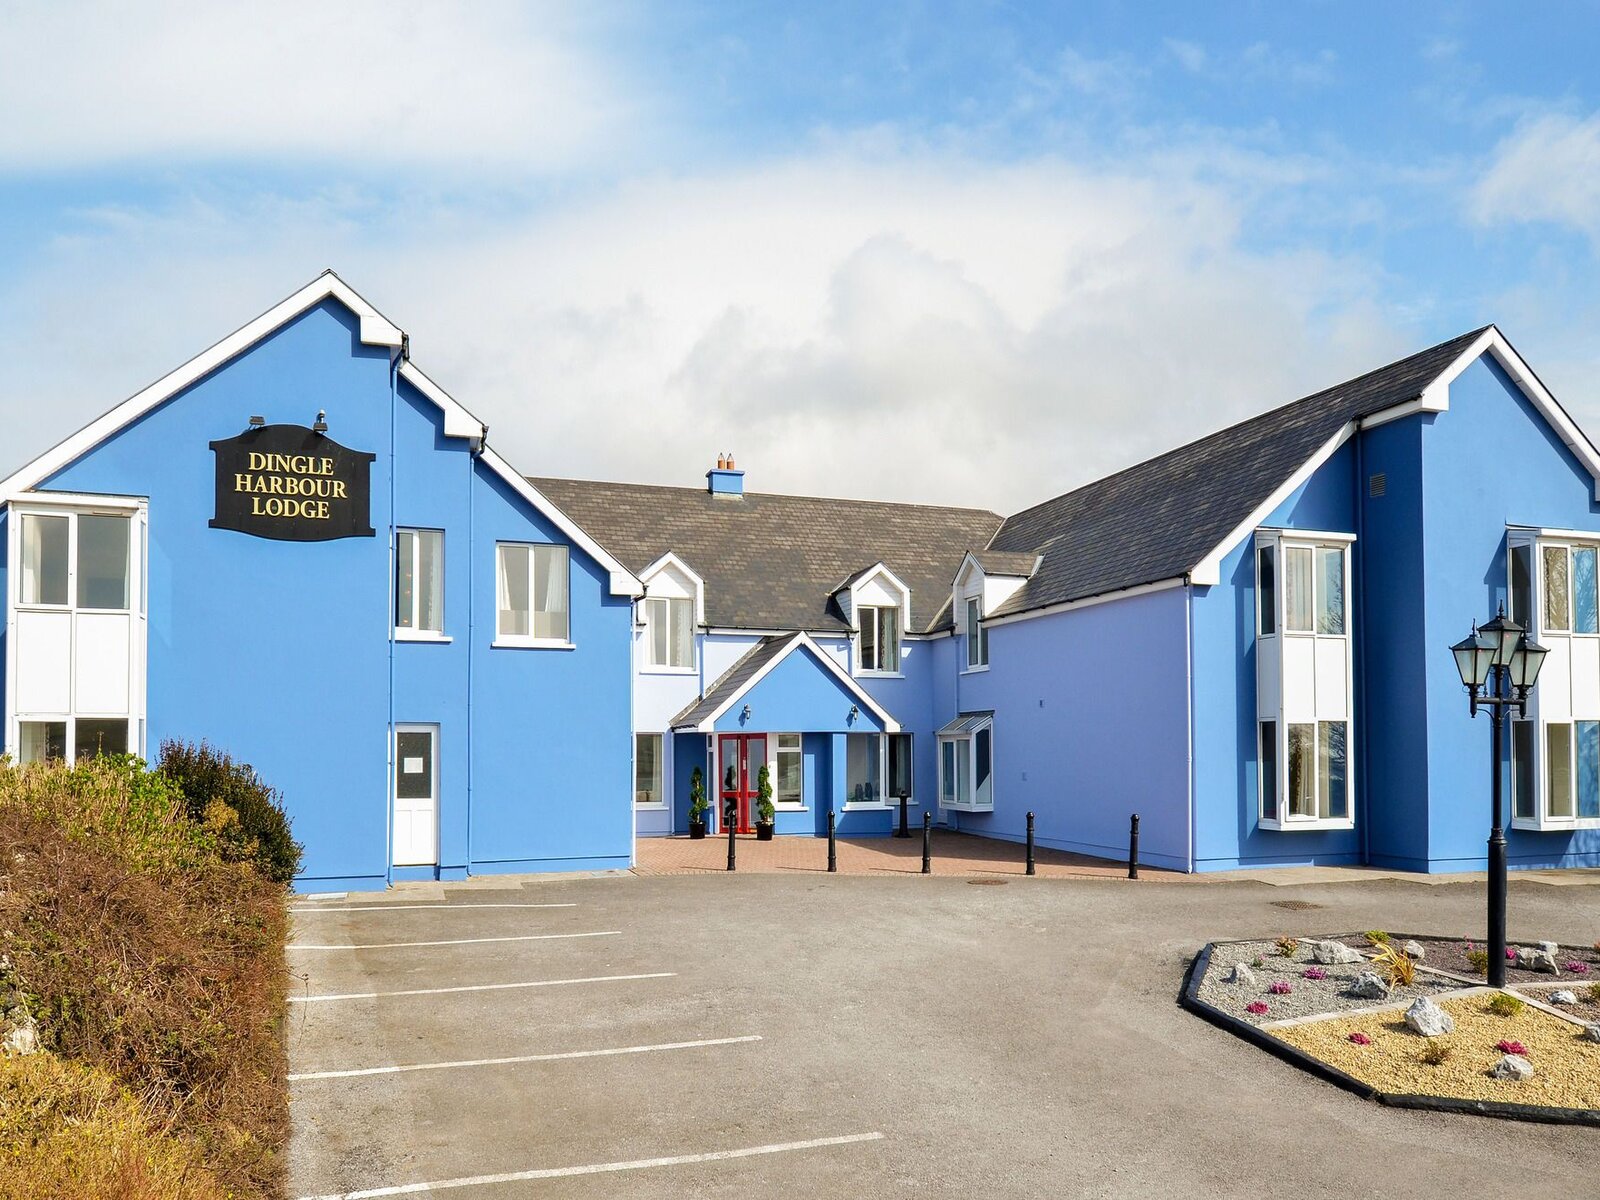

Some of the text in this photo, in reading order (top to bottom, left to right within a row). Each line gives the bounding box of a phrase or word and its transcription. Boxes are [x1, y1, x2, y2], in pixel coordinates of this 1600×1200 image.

[248, 452, 334, 476] DINGLE
[234, 473, 348, 499] HARBOUR
[251, 496, 330, 519] LODGE
